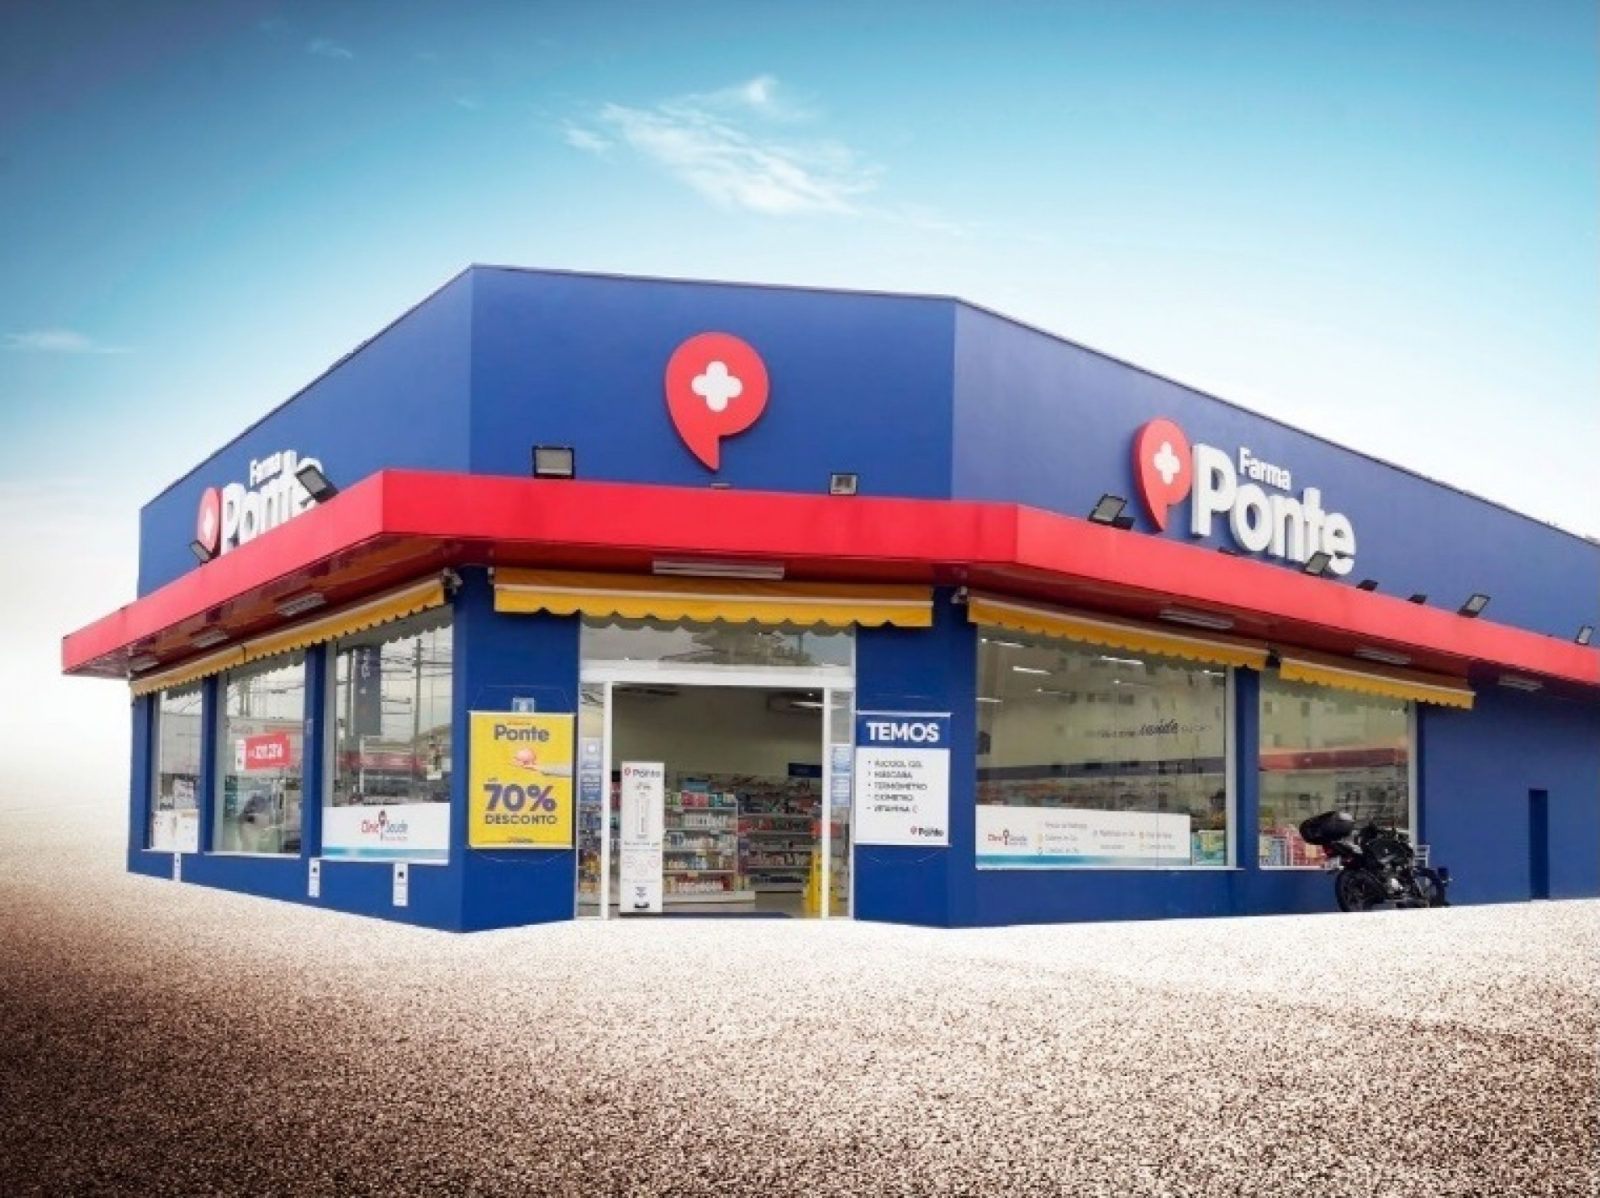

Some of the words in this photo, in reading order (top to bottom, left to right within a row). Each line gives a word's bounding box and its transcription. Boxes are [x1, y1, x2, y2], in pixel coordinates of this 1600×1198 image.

[1238, 446, 1292, 491] Farma
[1191, 443, 1357, 576] Ponte
[493, 723, 550, 742] Ponte
[865, 721, 941, 743] TEMOS
[483, 783, 558, 813] 70%
[484, 814, 558, 825] DESCONTO
